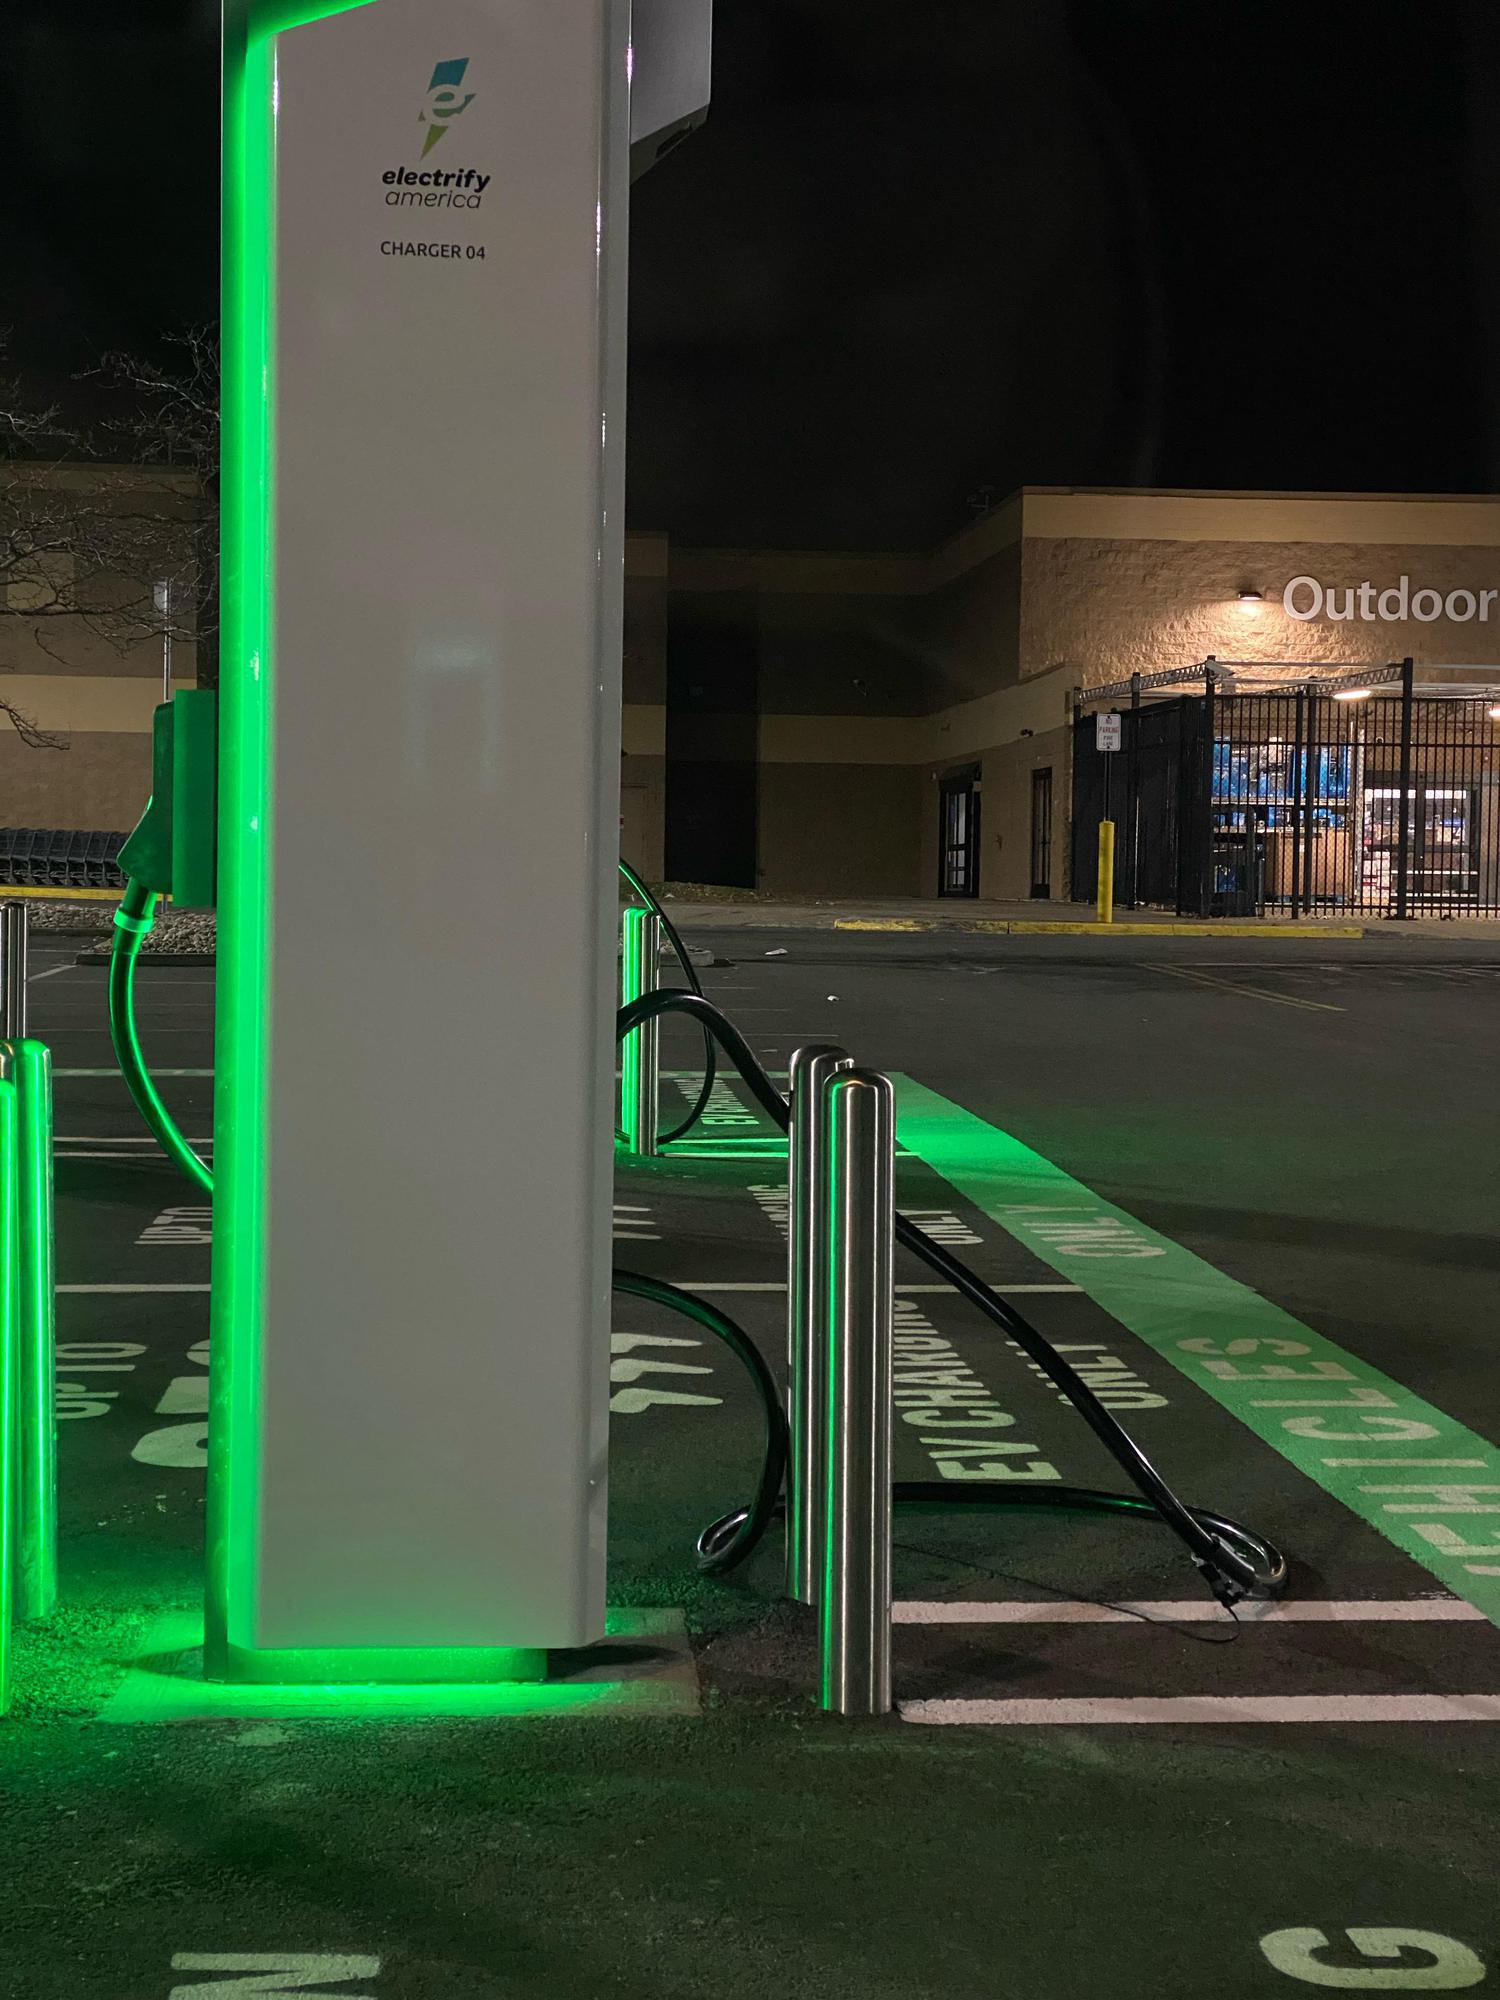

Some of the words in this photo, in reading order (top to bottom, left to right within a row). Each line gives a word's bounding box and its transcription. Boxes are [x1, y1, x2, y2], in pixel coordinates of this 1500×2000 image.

[382, 166, 491, 193] electrify
[385, 190, 482, 209] america
[380, 241, 462, 259] CHARGER
[466, 245, 486, 260] 04
[1283, 575, 1499, 622] Outdoor
[700, 1113, 760, 1125] EV
[895, 1208, 985, 1245] ONLY
[996, 1204, 1168, 1258] ONLY
[893, 1300, 1017, 1428] CHARG
[1005, 1341, 1169, 1410] ONLY
[919, 1437, 1062, 1480] EV
[1176, 1338, 1500, 1577] HICLES
